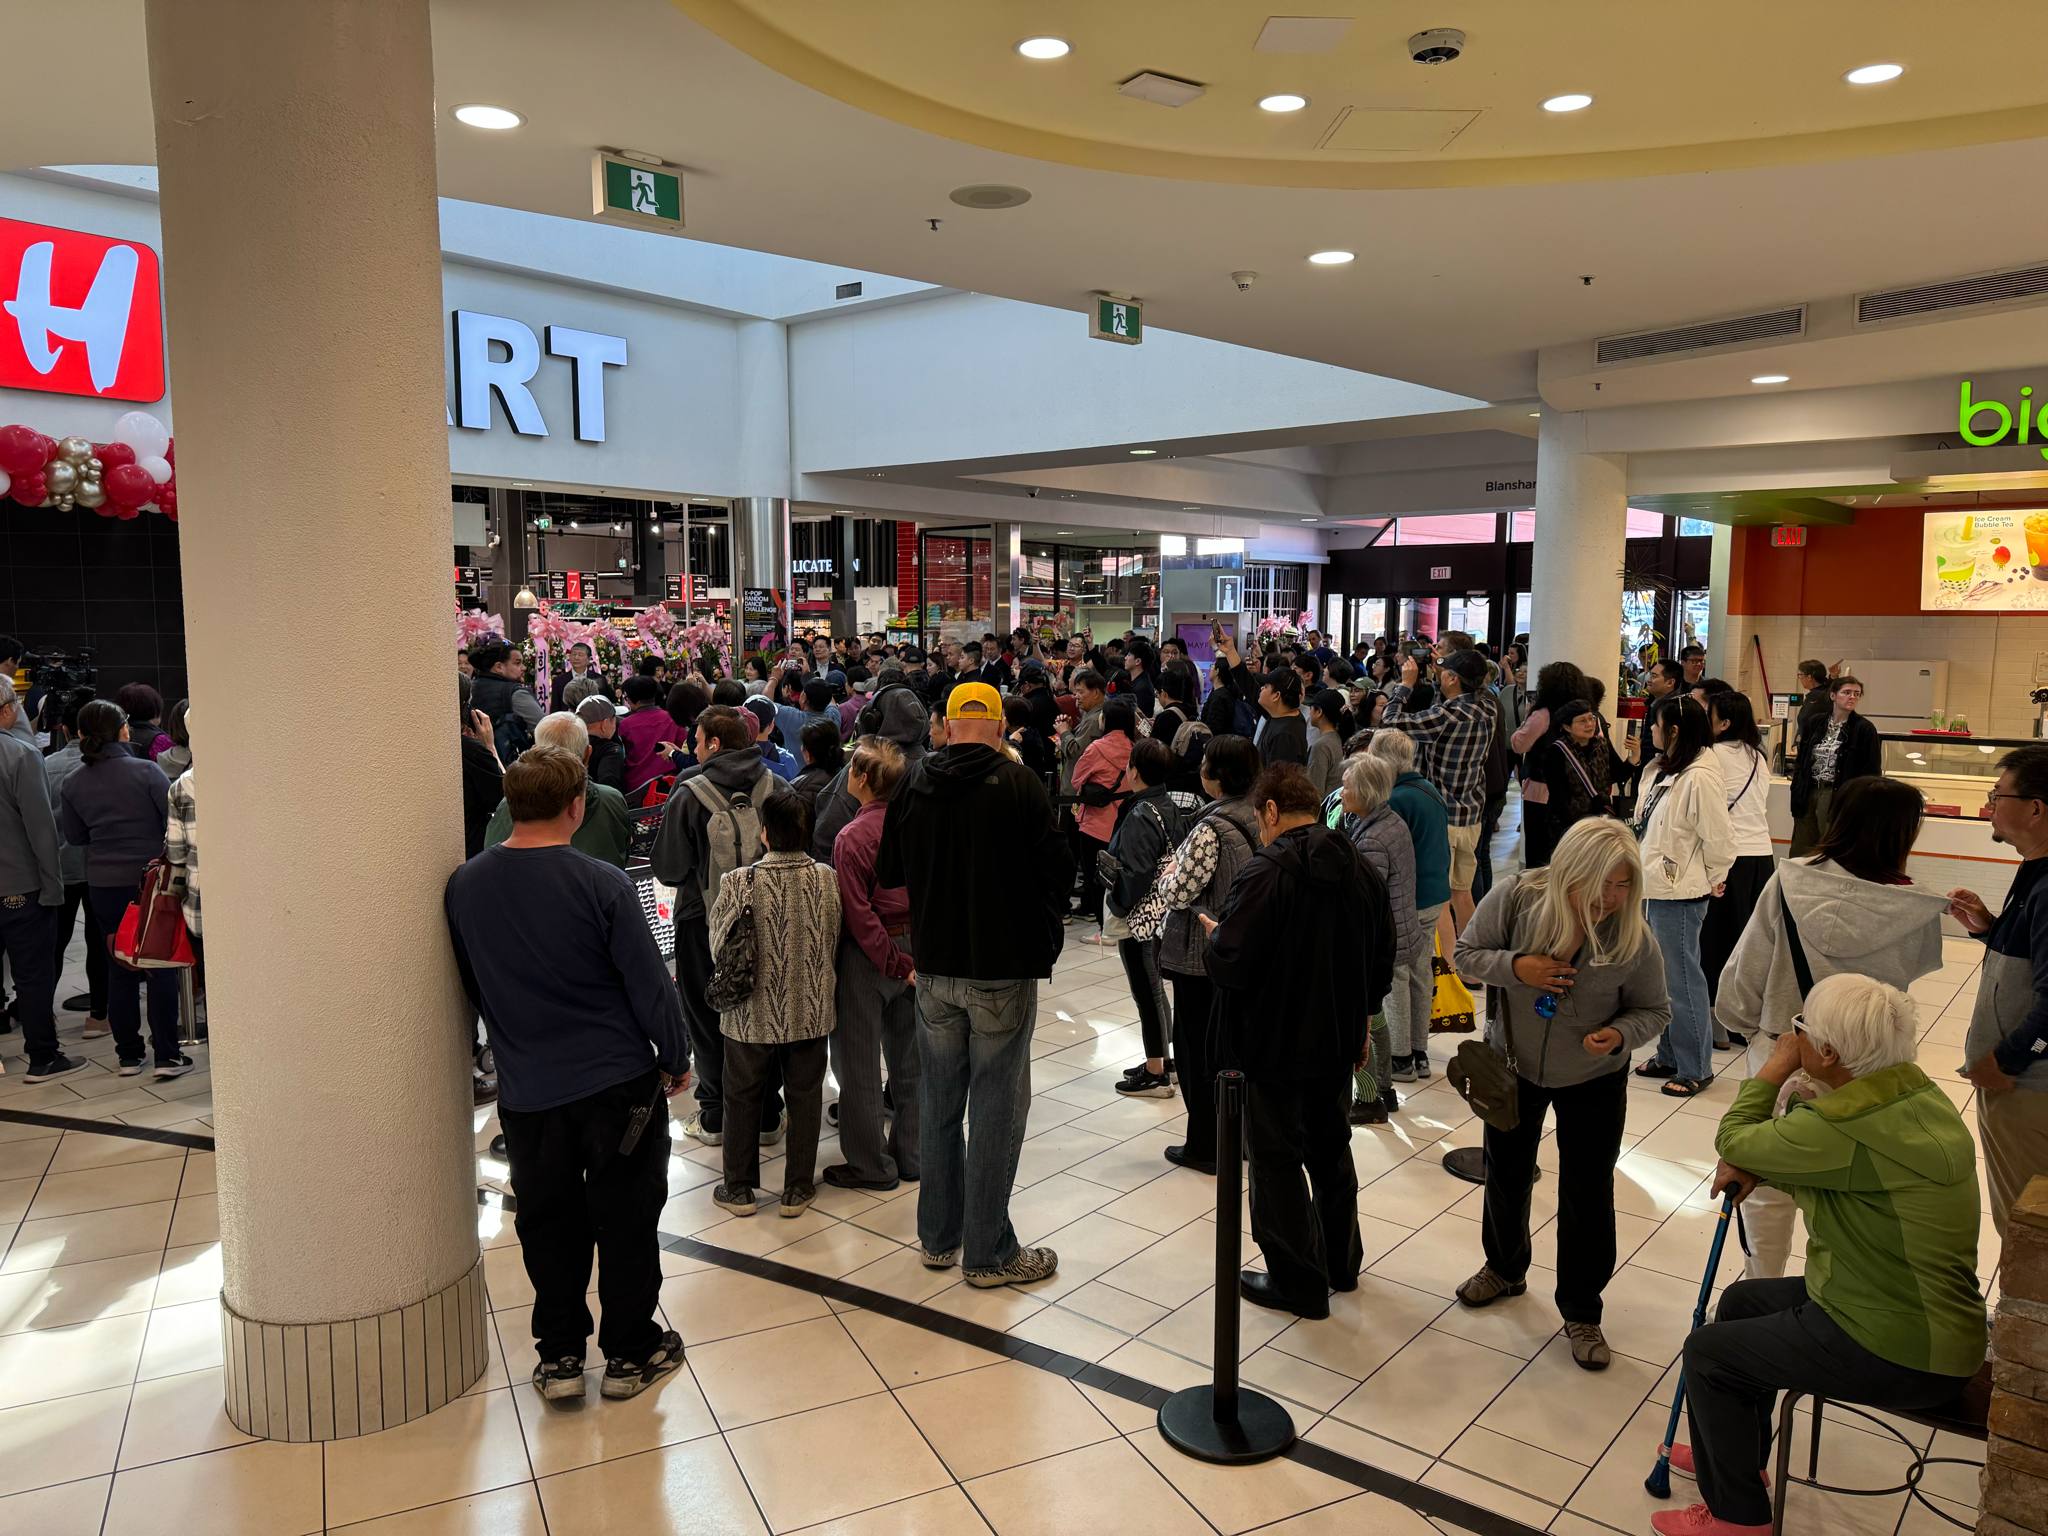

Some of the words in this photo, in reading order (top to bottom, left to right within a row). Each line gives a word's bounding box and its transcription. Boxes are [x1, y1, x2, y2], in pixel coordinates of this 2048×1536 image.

[3, 241, 139, 393] H
[447, 309, 628, 443] RT
[1777, 527, 1803, 545] EXIT
[1432, 568, 1448, 578] EXIT
[569, 580, 578, 593] 7
